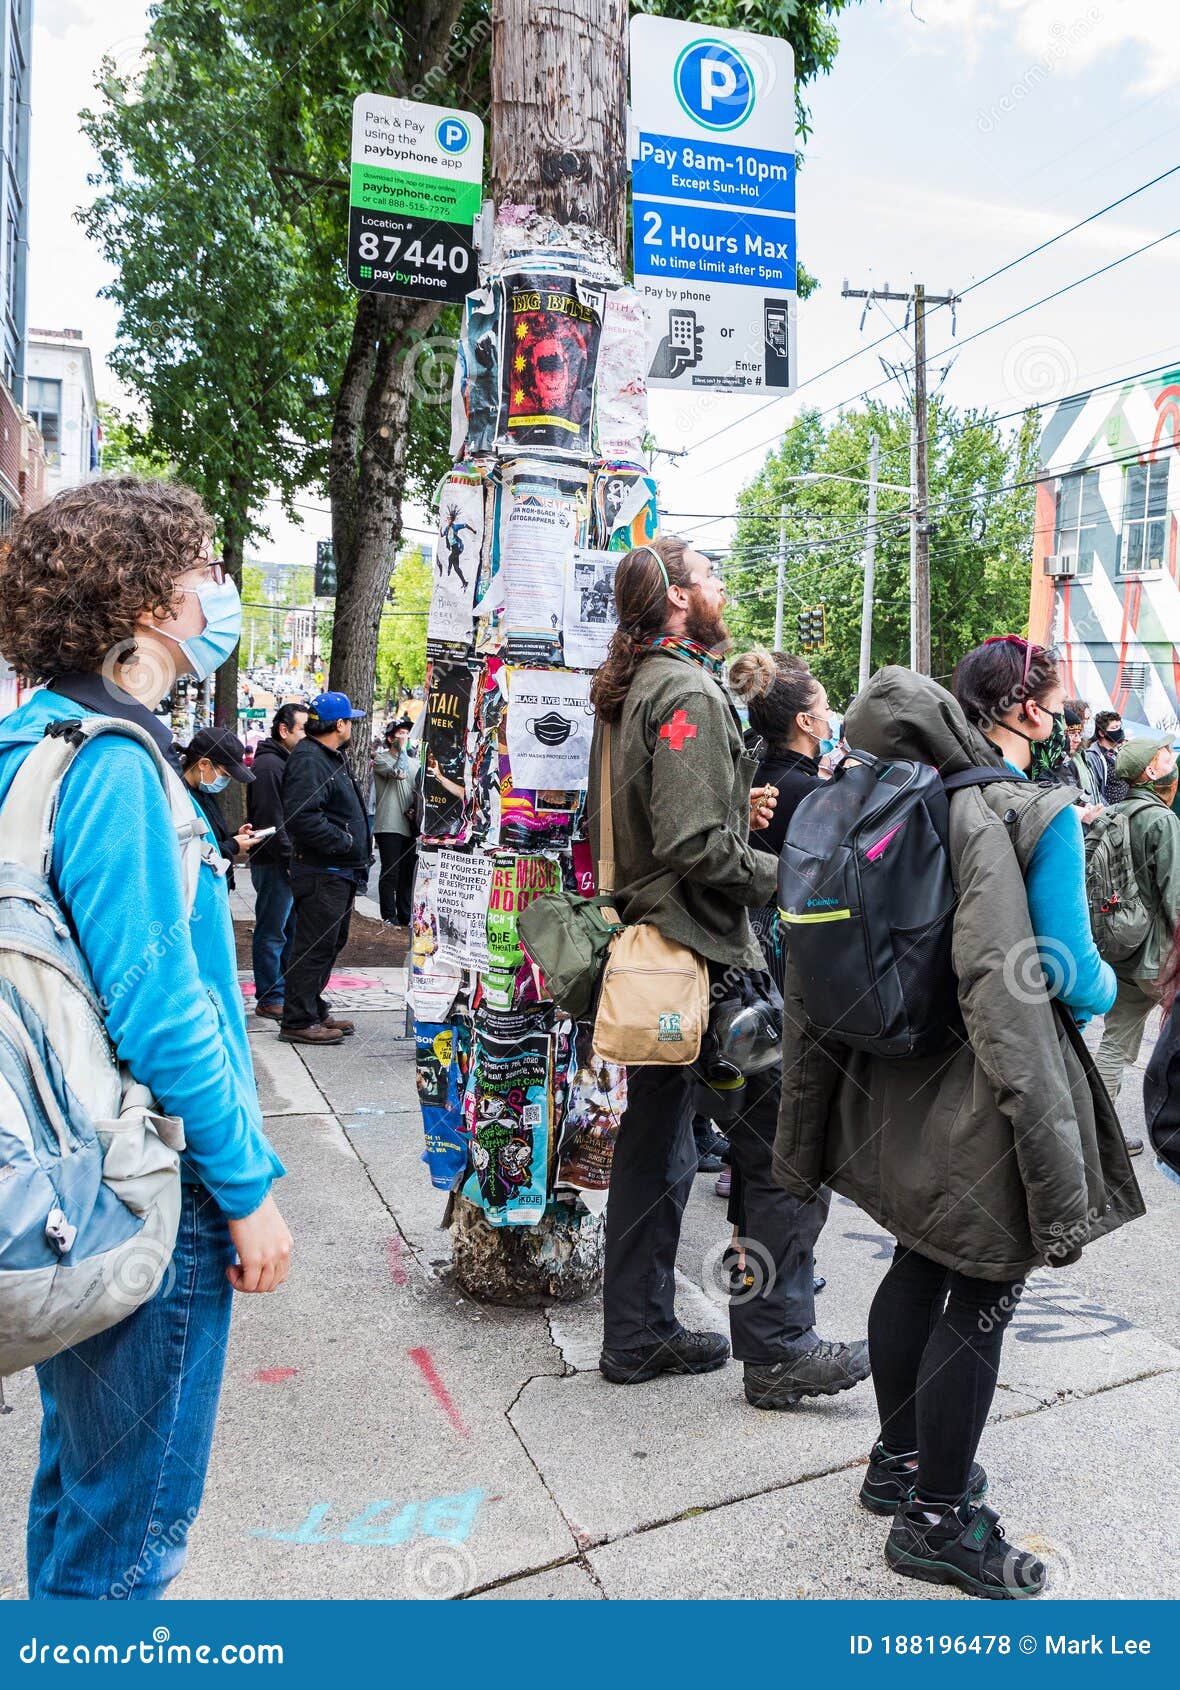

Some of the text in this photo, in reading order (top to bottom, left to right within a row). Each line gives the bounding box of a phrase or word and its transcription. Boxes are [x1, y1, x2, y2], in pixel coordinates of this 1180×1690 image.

[701, 58, 736, 111] P
[365, 112, 425, 133] Park & Pay
[365, 129, 417, 145] using the
[446, 125, 462, 146] P
[364, 144, 463, 170] paybyphone app
[640, 141, 787, 182] Pay 8am-10pm
[362, 181, 457, 204] paybyphone.com
[671, 174, 759, 197] Except Sun-Hol
[362, 195, 450, 216] or call 888-515-7275
[361, 216, 413, 232] Location #
[643, 211, 789, 260] 2 Hours Max
[358, 232, 469, 274] 87440
[650, 254, 783, 280] No time limit after 5pm
[374, 268, 448, 288] paybyphone
[644, 286, 711, 302] Pay by phone
[512, 293, 593, 323] BIG BITE
[720, 327, 735, 338] or
[735, 361, 762, 371] Enter
[755, 376, 762, 386] #
[515, 695, 538, 705] BLACK
[541, 696, 560, 706] LIVES
[431, 717, 454, 729] WEEK
[429, 795, 447, 804] 2020
[441, 852, 485, 866] REMEMBER
[439, 870, 449, 879] BE
[440, 861, 450, 870] BE
[451, 863, 492, 877] YOURSELF
[438, 878, 445, 886] BE
[436, 896, 459, 907] HANDS
[437, 887, 475, 900] WASH YOUR
[436, 906, 452, 914] KEEP
